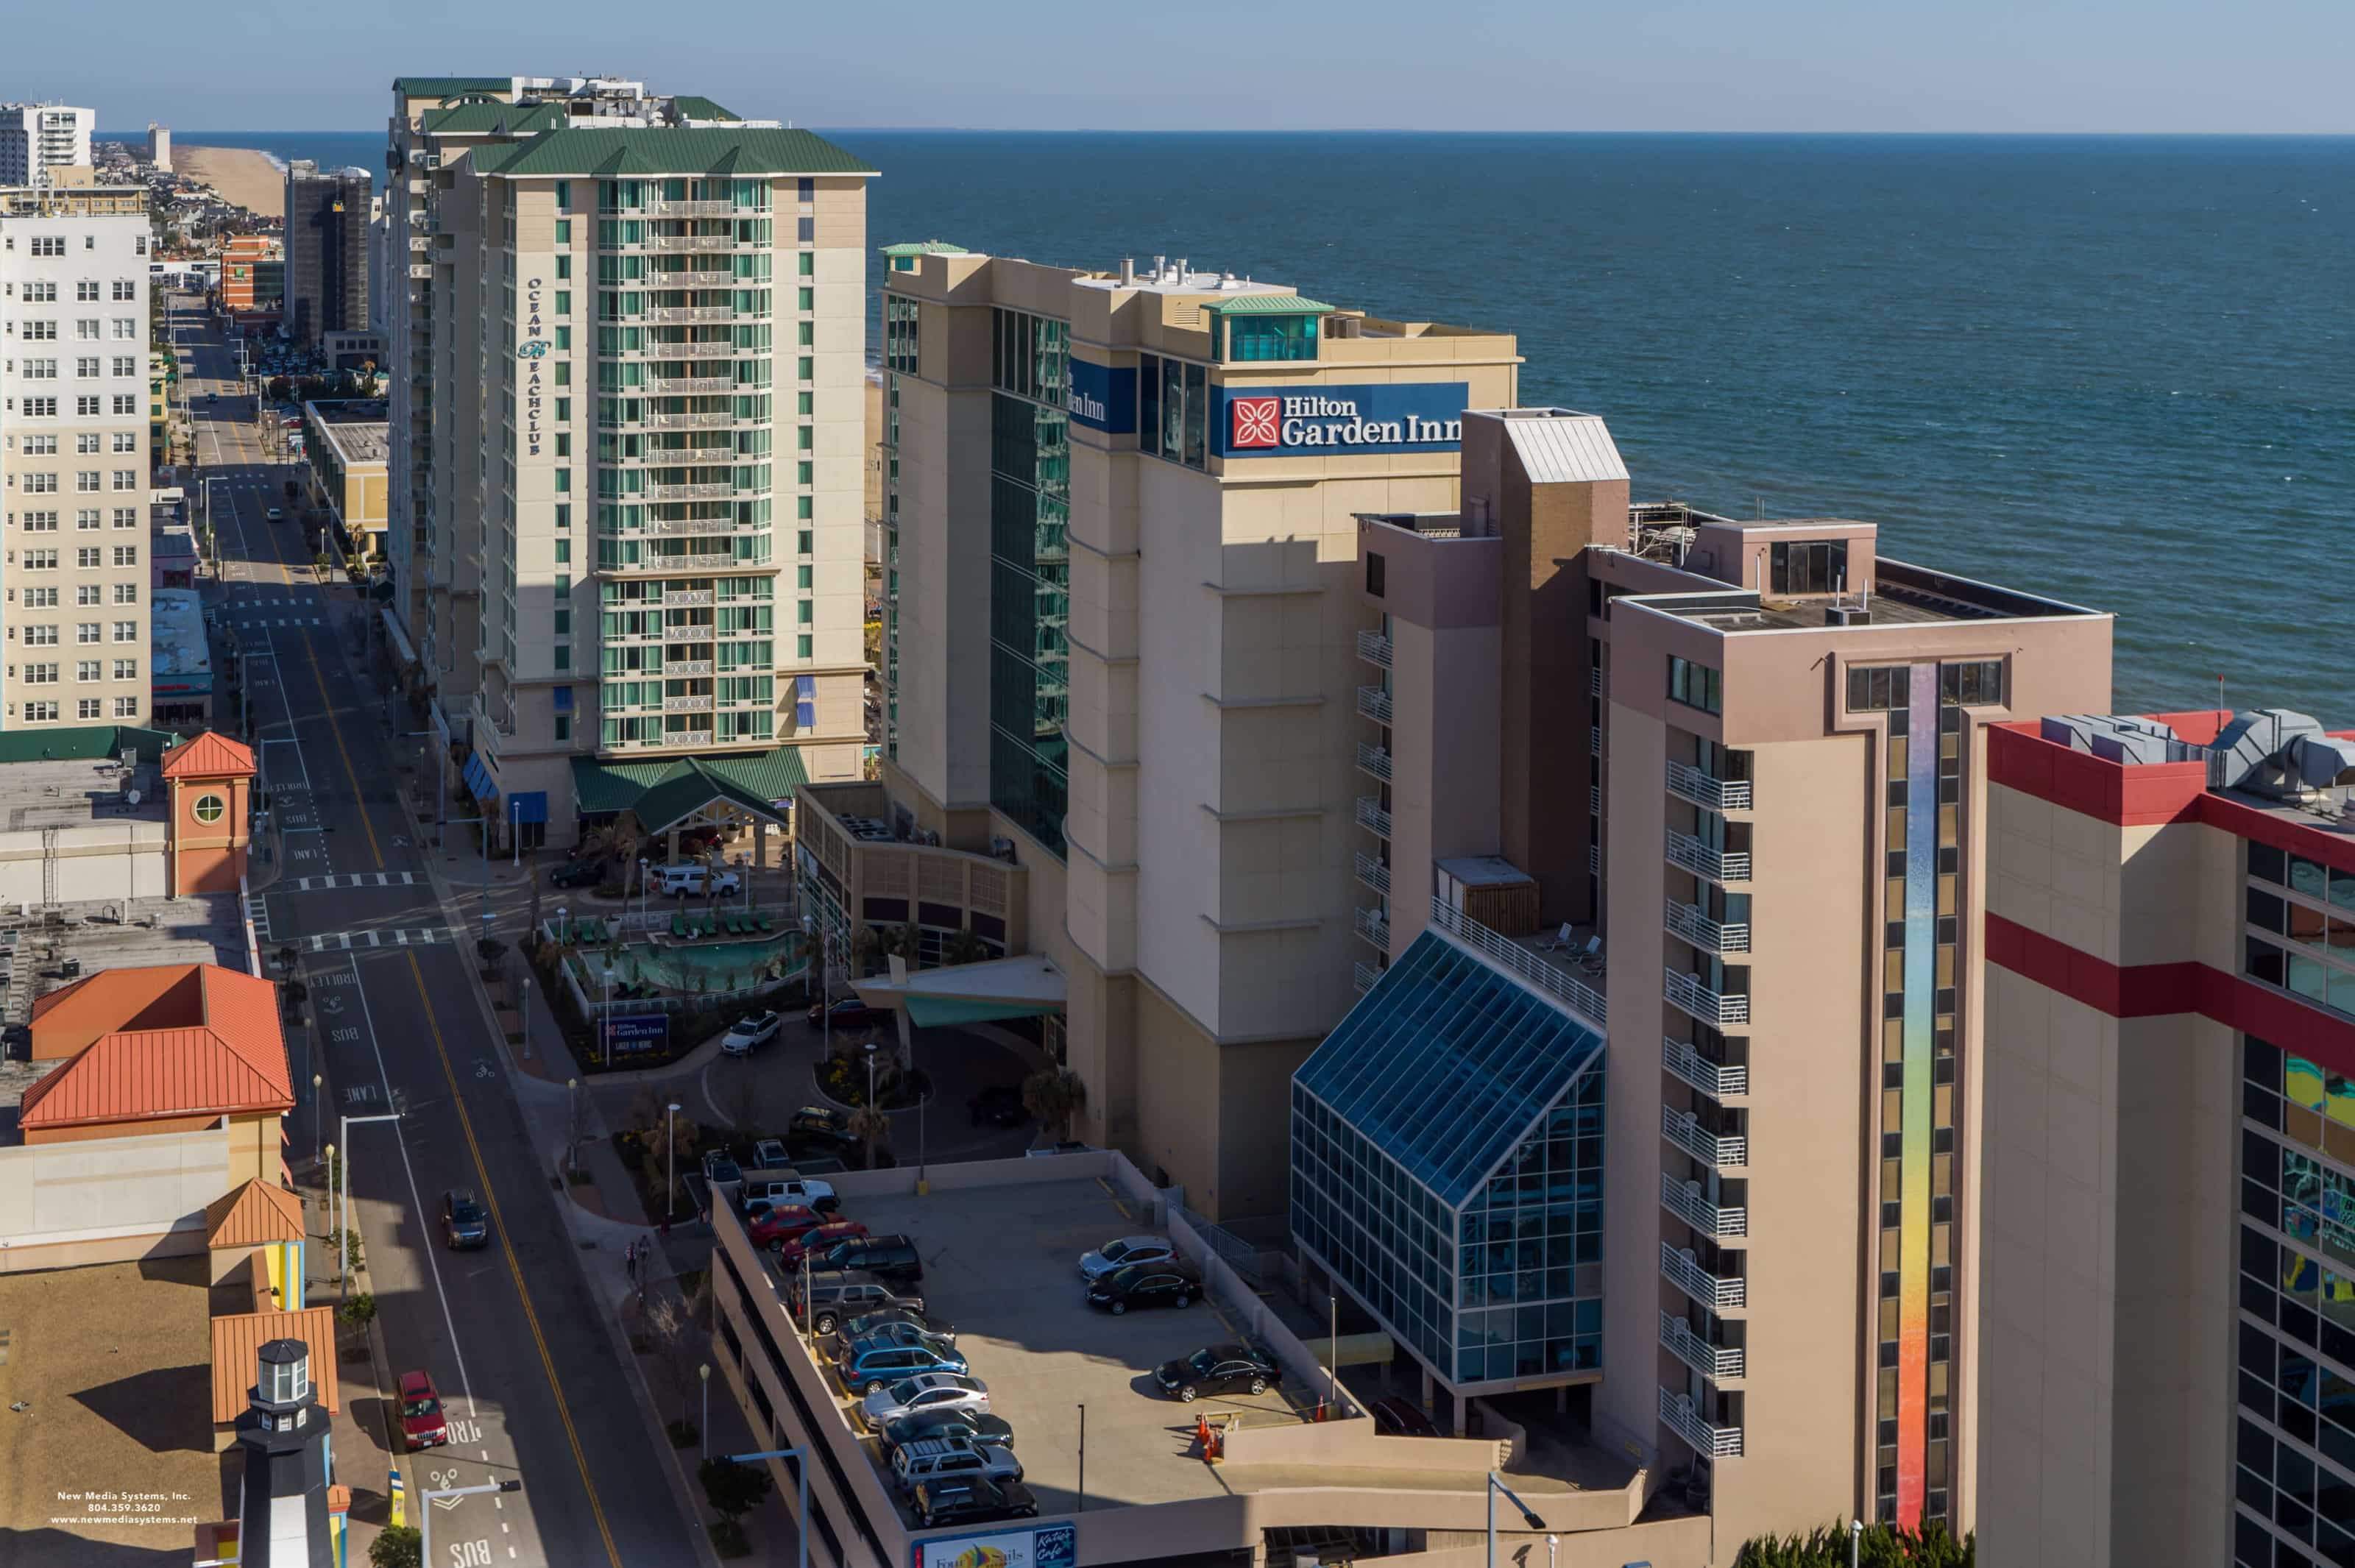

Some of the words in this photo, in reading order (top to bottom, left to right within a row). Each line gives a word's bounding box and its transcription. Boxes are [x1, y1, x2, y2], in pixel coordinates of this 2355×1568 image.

[528, 277, 542, 337] OCEAN
[1083, 392, 1106, 422] Inn
[1283, 397, 1358, 417] Hilton
[1282, 416, 1403, 447] Garden
[286, 814, 307, 824] BUS
[310, 973, 356, 989] TROLLEY
[331, 1026, 359, 1043] BUS
[344, 1085, 378, 1103] LANE
[450, 1539, 492, 1568] BUS
